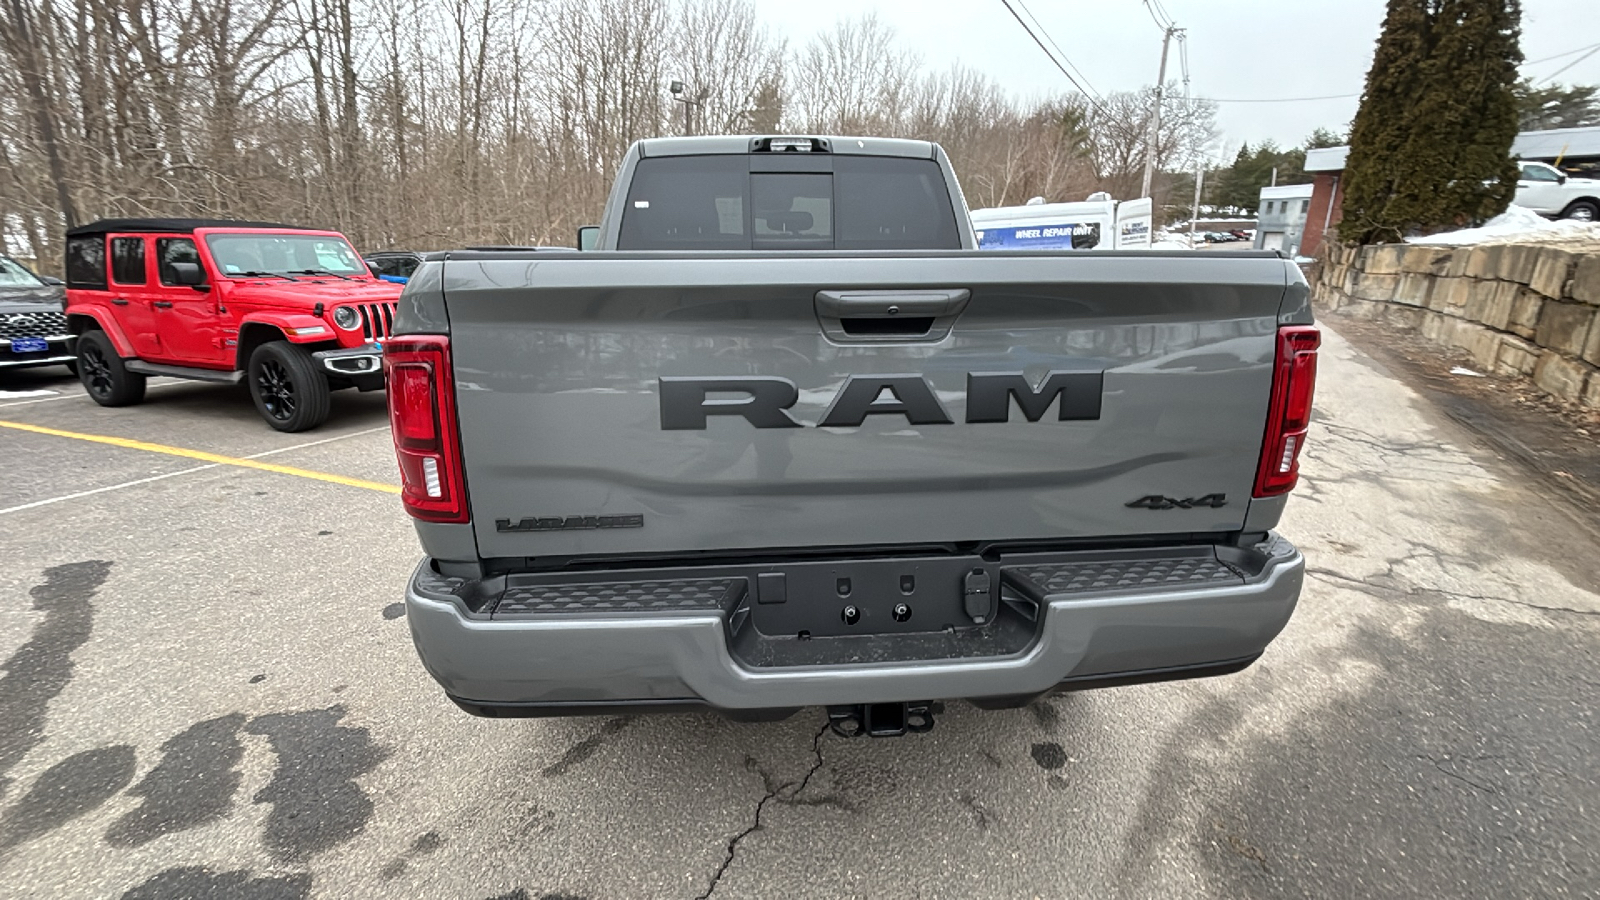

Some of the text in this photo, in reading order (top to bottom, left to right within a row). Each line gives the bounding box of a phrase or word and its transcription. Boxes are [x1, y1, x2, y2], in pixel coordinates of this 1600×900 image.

[1015, 226, 1094, 239] WHEEL REPAIR UNIT
[659, 369, 1104, 430] RAM
